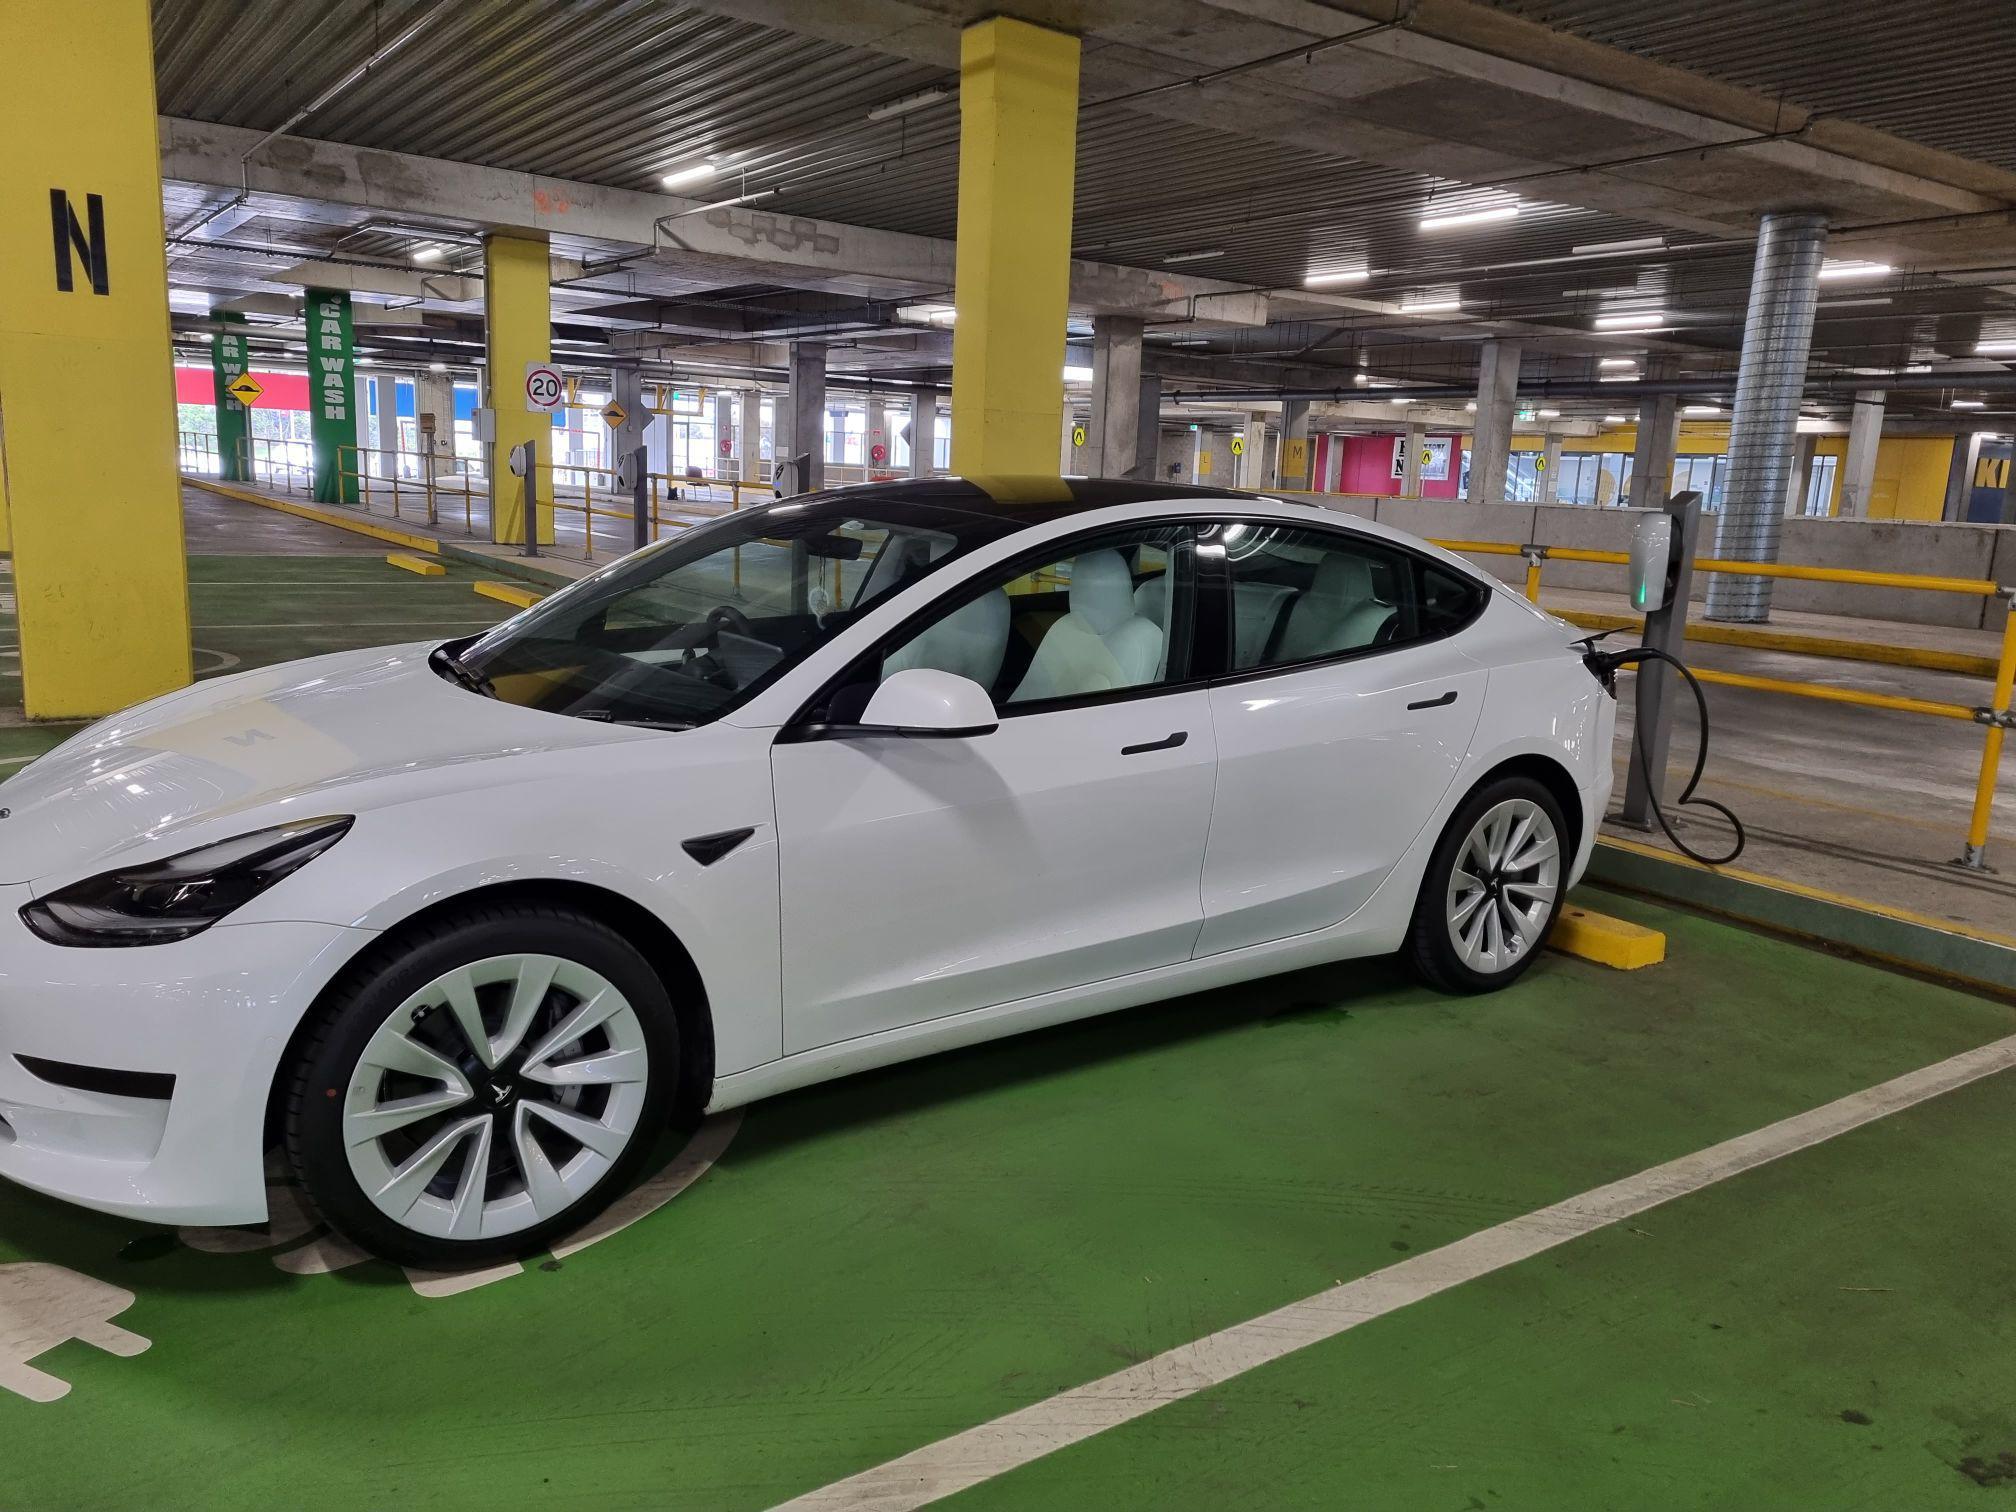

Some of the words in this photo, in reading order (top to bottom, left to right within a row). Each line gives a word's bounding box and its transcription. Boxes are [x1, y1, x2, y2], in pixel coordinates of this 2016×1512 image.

[50, 188, 109, 296] N
[319, 302, 342, 351] CAR
[221, 335, 240, 358] AR
[319, 357, 346, 420] WASH
[532, 378, 558, 397] 20
[1292, 446, 1303, 460] M
